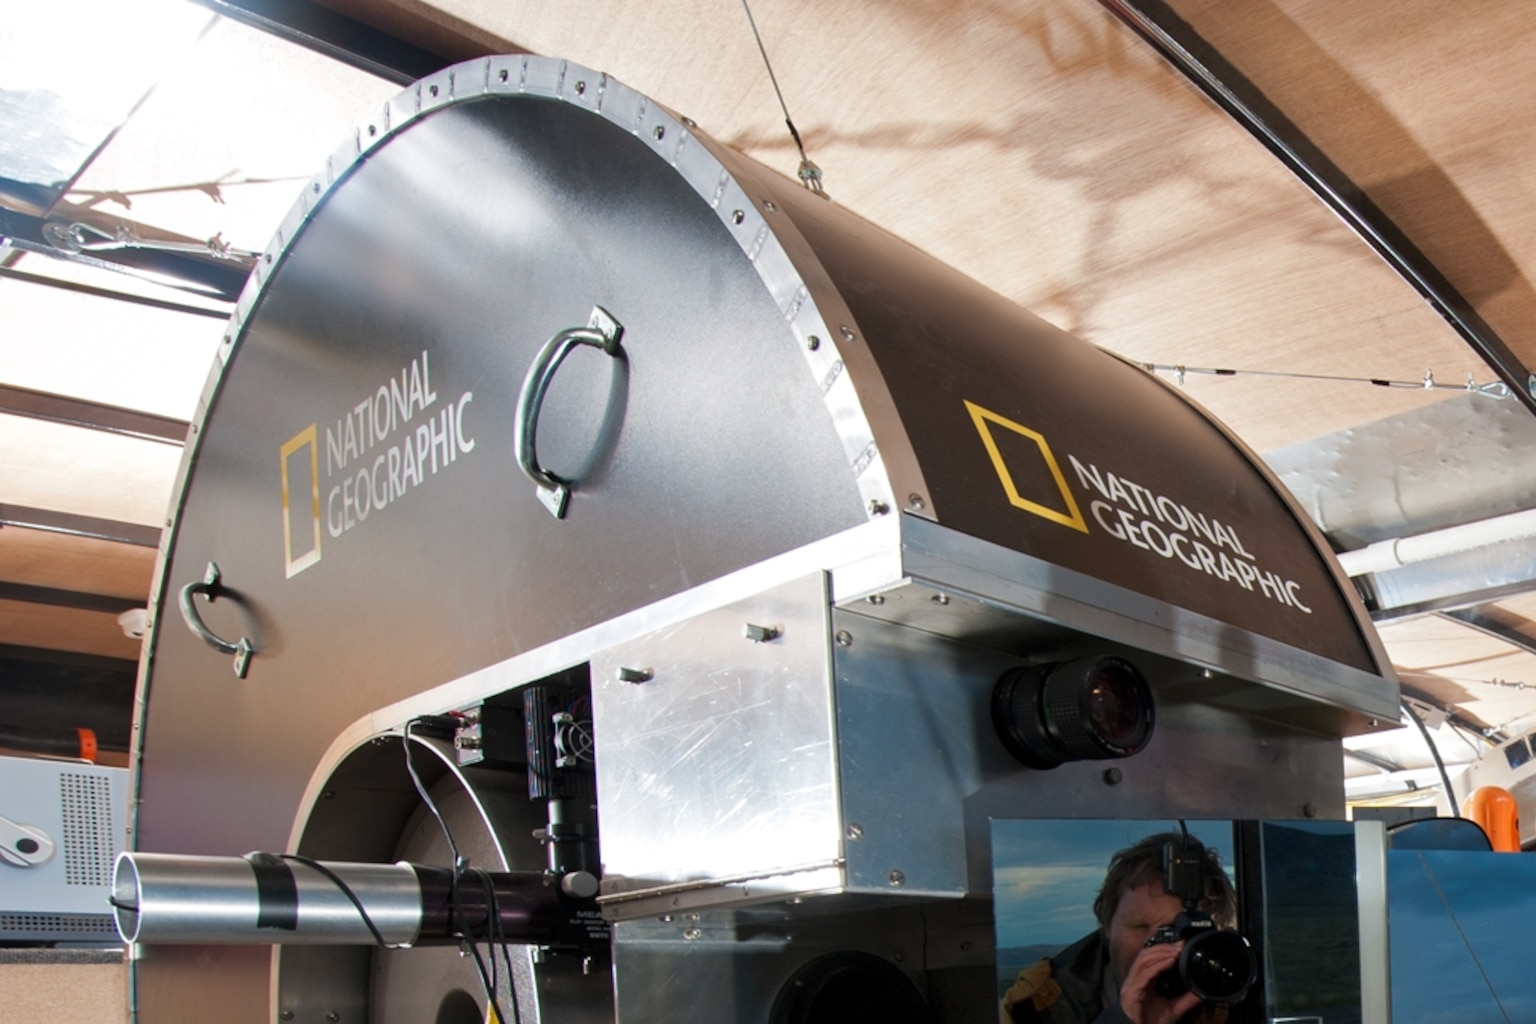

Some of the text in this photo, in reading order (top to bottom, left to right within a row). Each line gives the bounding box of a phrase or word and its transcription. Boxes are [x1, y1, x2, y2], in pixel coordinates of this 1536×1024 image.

[326, 349, 437, 477] NATIONAL
[327, 391, 476, 538] GEOGRAPHIC
[1067, 453, 1256, 560] NATIONAL
[1089, 499, 1313, 614] GEOGRAPHIC
